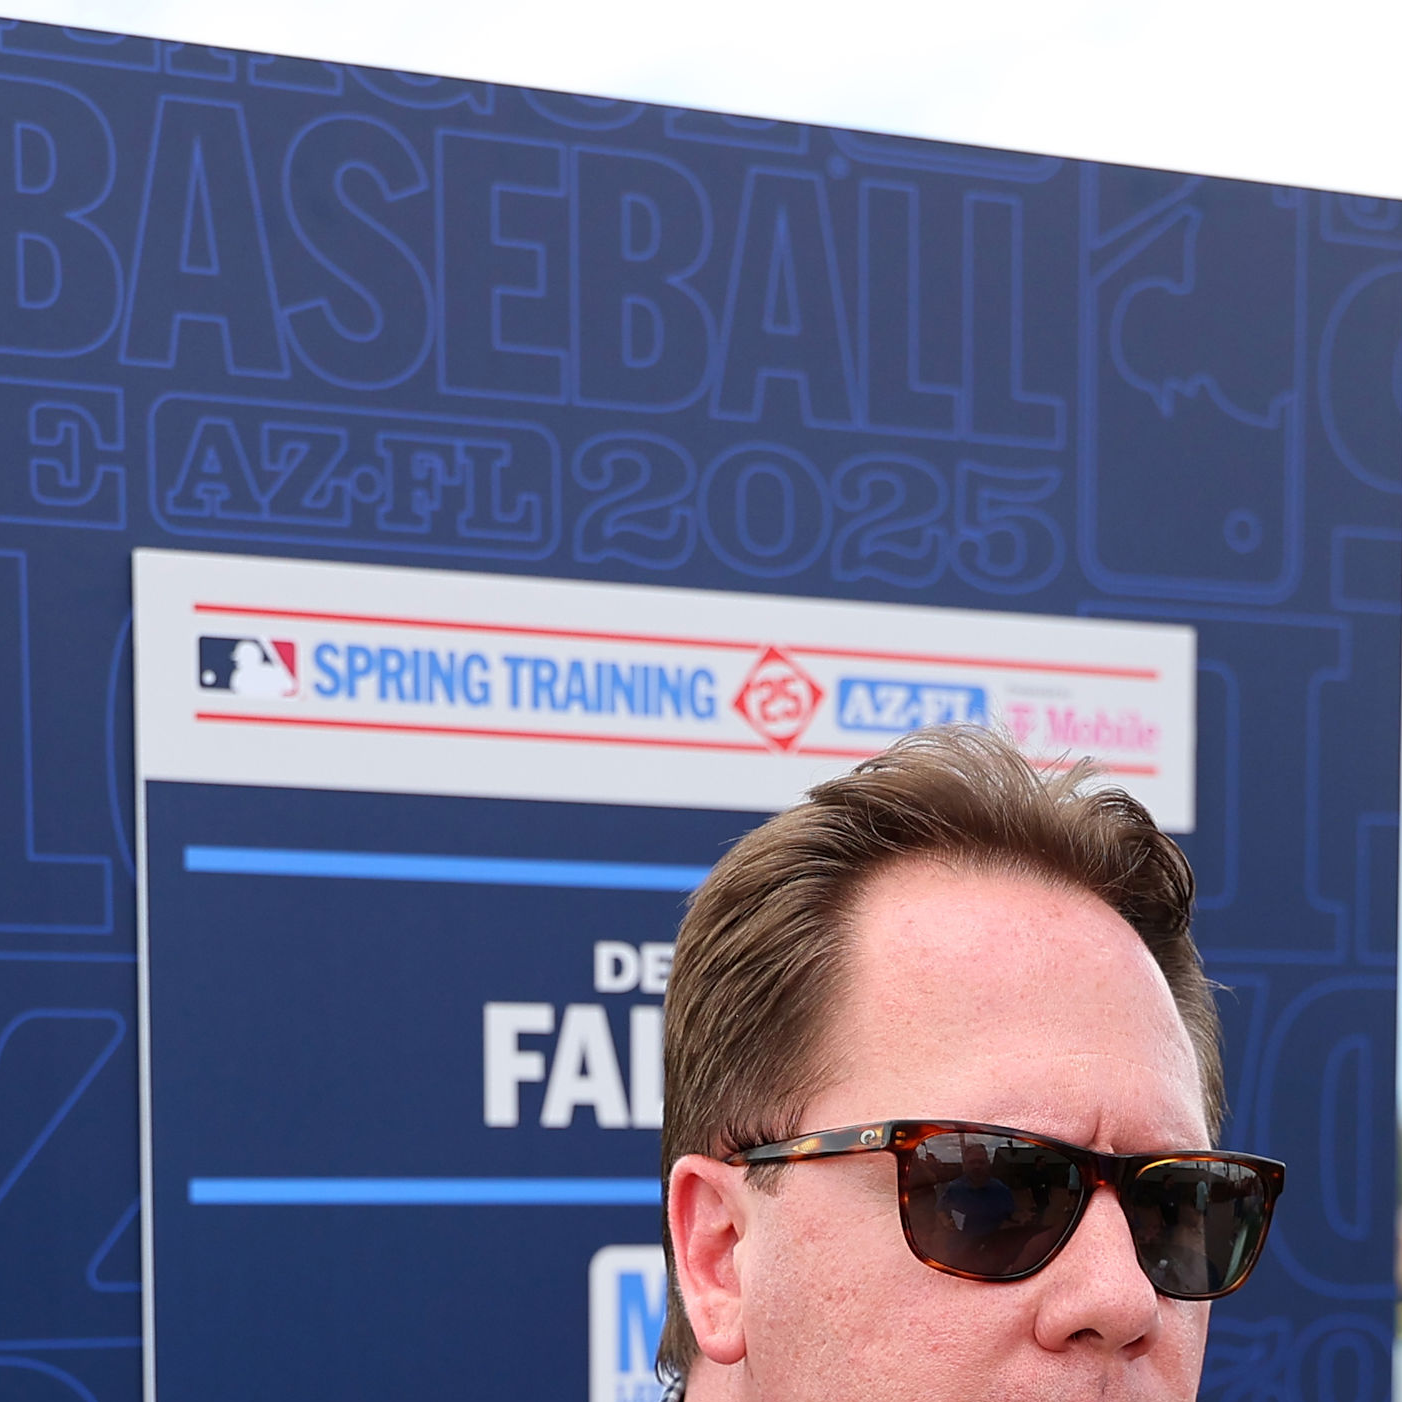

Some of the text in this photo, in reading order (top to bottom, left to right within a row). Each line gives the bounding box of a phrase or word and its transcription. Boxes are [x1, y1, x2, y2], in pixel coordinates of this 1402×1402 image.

[572, 430, 1068, 596] 2025
[314, 642, 717, 719] SPRING TRAINING
[594, 940, 675, 994] DE
[483, 1003, 664, 1129] FAL
